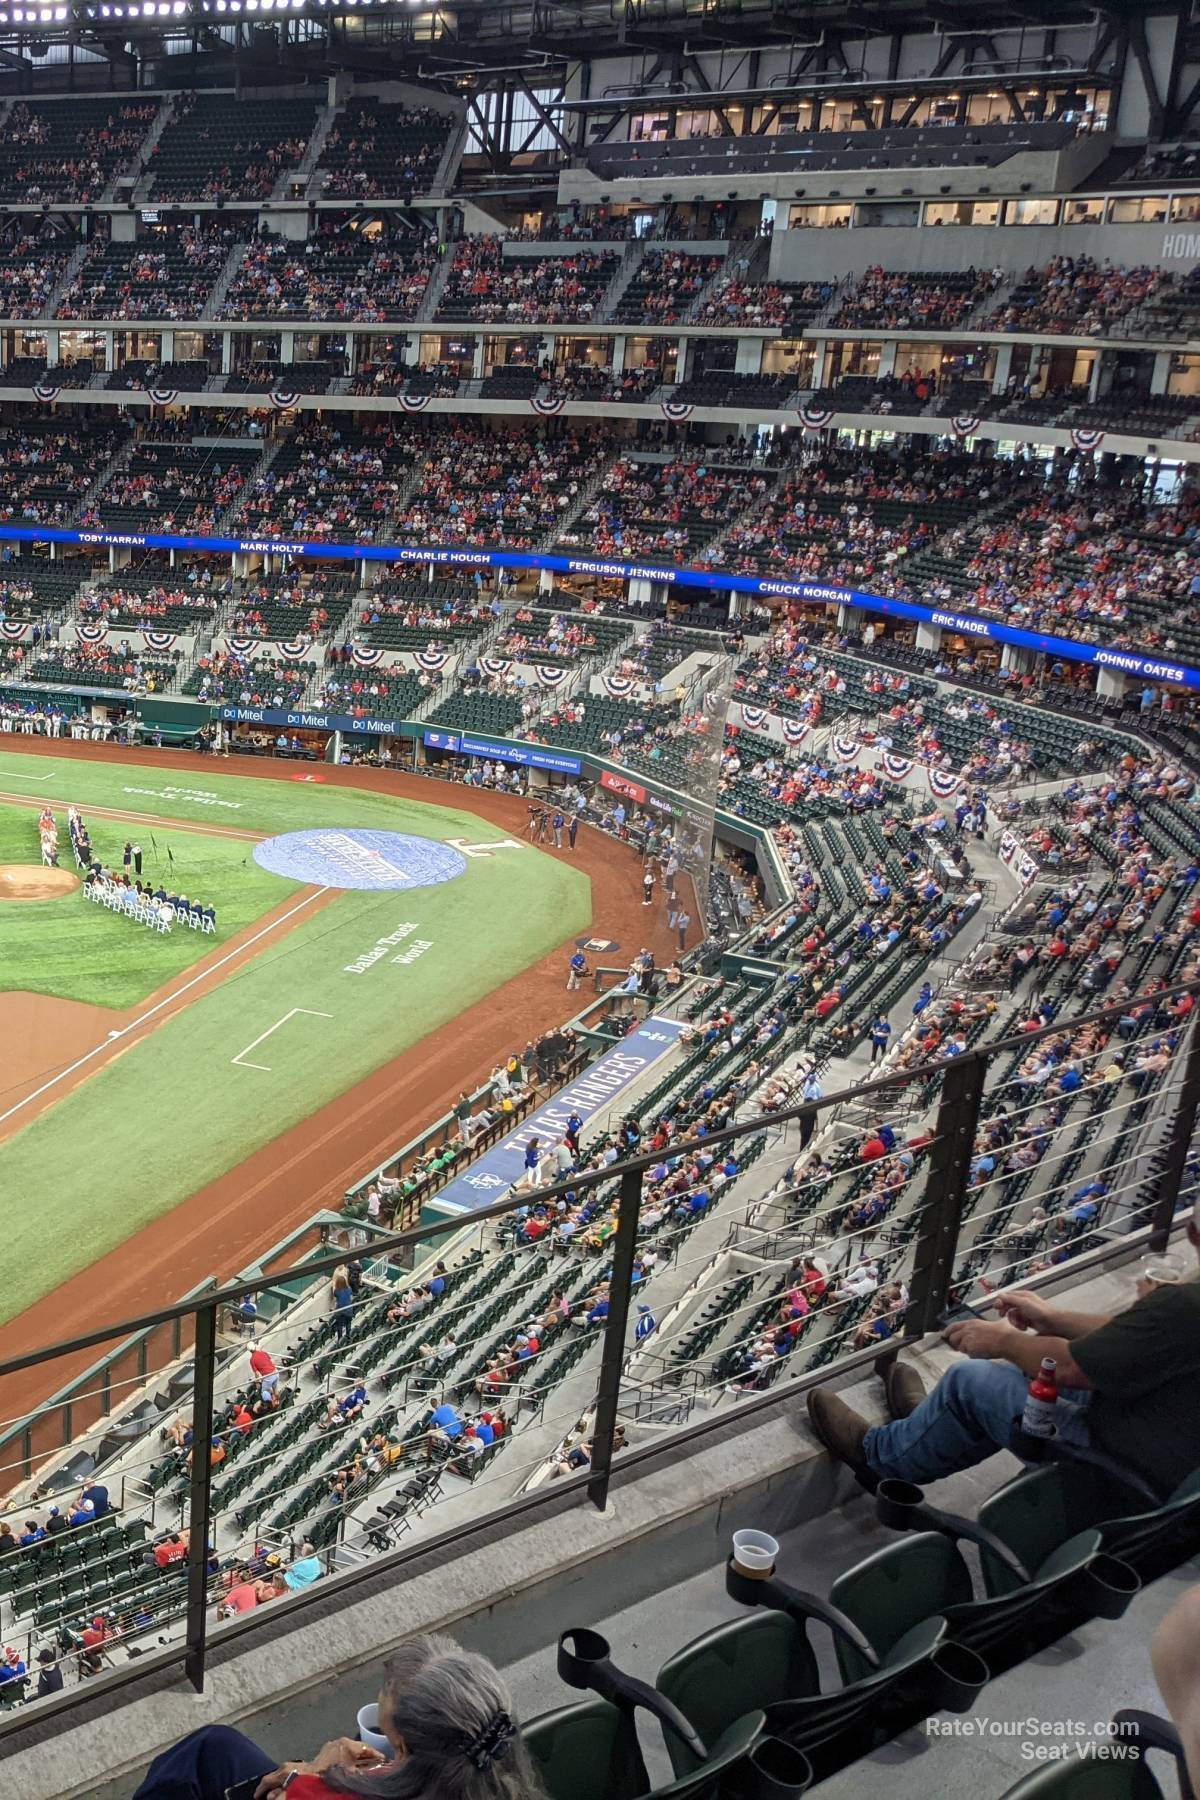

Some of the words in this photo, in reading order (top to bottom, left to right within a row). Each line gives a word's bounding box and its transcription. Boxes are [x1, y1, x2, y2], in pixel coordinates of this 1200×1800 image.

[78, 533, 103, 542] TOBY
[105, 535, 145, 545] HARRAH
[240, 542, 269, 552] MARK
[271, 544, 304, 553] HOLTZ
[400, 551, 447, 561] CHARLIE
[450, 553, 490, 563] HOUGH
[569, 561, 625, 576] FERGUSON
[759, 582, 800, 595] CHUCK
[803, 587, 852, 602] MORGAN
[931, 613, 954, 627] ERIC
[956, 619, 990, 635] NADEL
[1092, 651, 1141, 671] JOHNNY
[1143, 663, 1184, 681] OATES
[237, 709, 264, 721] Mitel
[301, 715, 328, 727] Mitel
[367, 721, 395, 733] Mitel
[343, 946, 389, 974] Dallas
[376, 922, 420, 945] Truck
[390, 939, 434, 964] World
[562, 1052, 647, 1111] RANGERS
